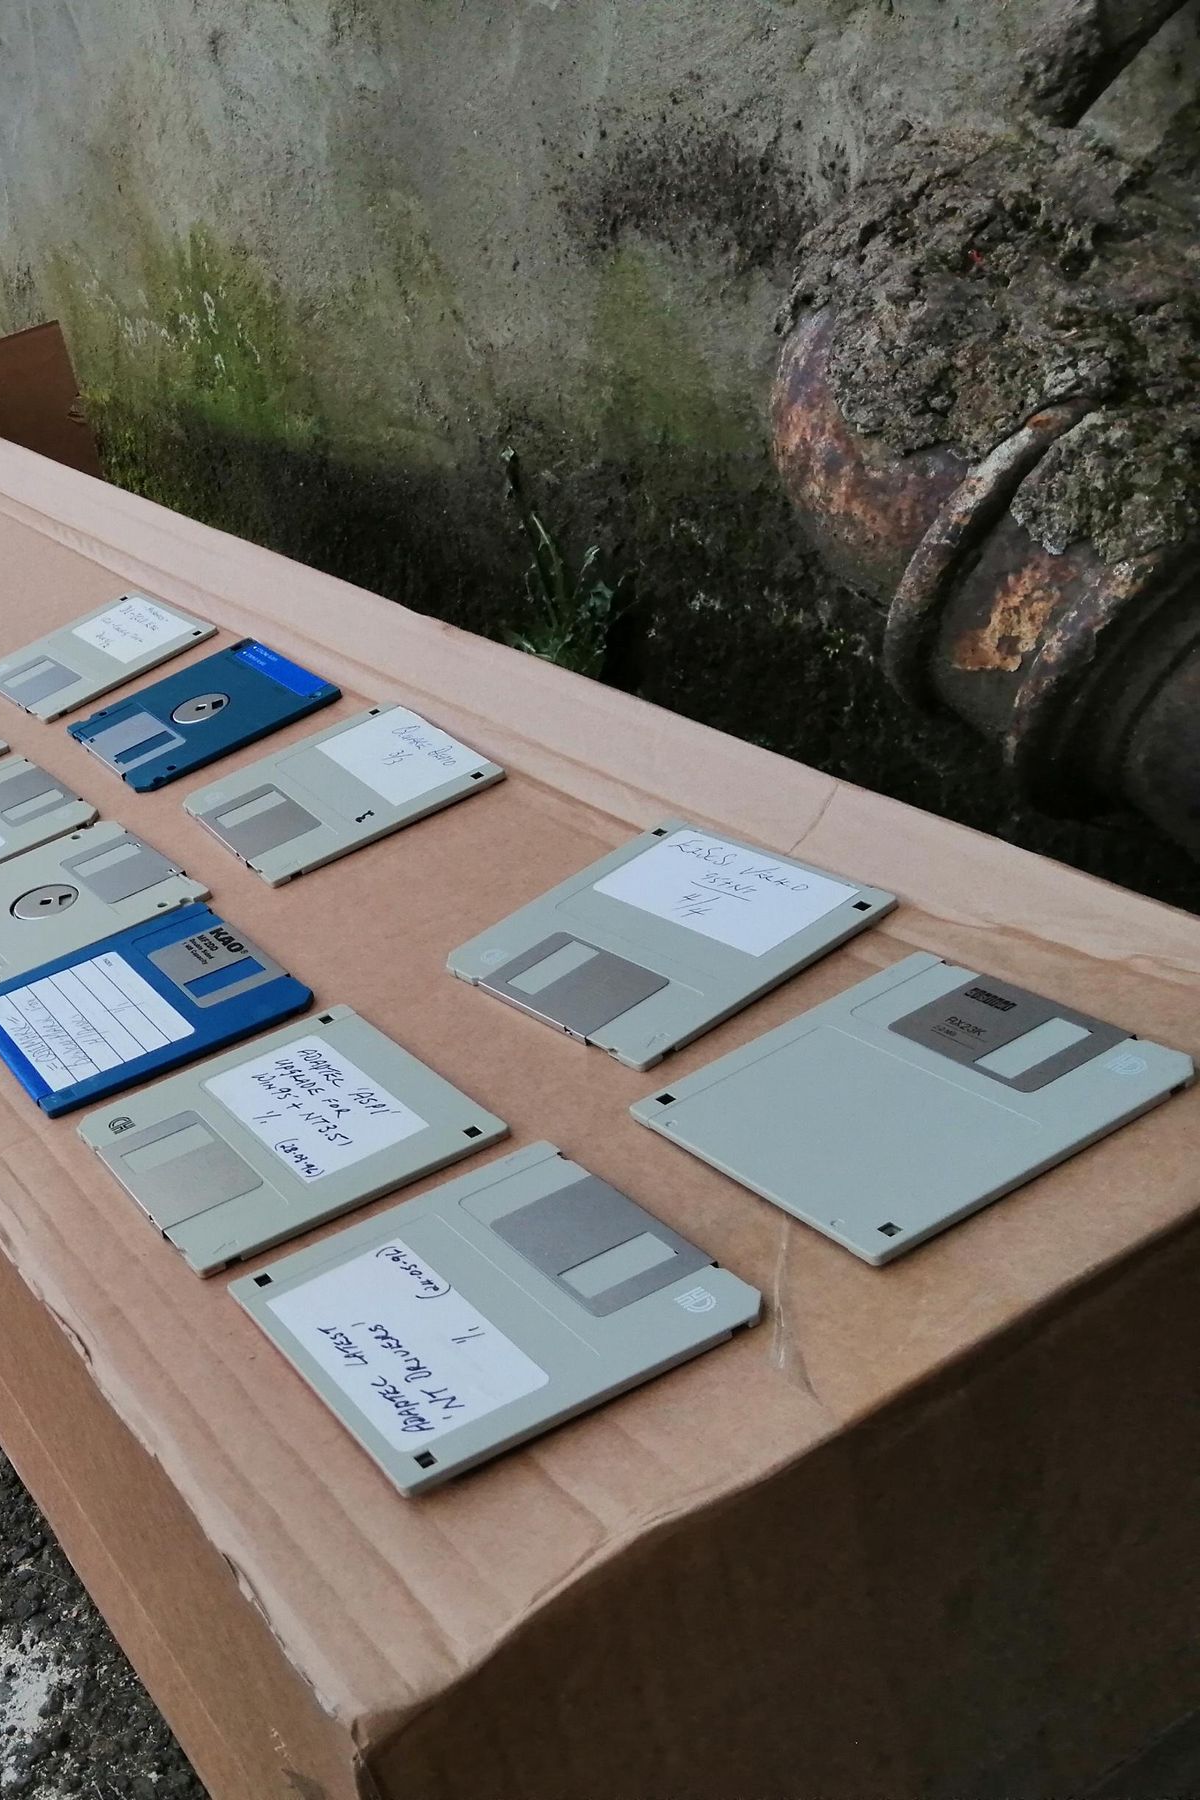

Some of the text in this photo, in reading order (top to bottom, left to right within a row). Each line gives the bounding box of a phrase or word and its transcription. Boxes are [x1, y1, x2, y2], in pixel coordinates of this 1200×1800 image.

[209, 927, 244, 953] KAO
[275, 1059, 351, 1118] UPGRADE FOR
[297, 1049, 345, 1088] ADAPTEC
[317, 1326, 435, 1432] ADAPTEC LATEST
